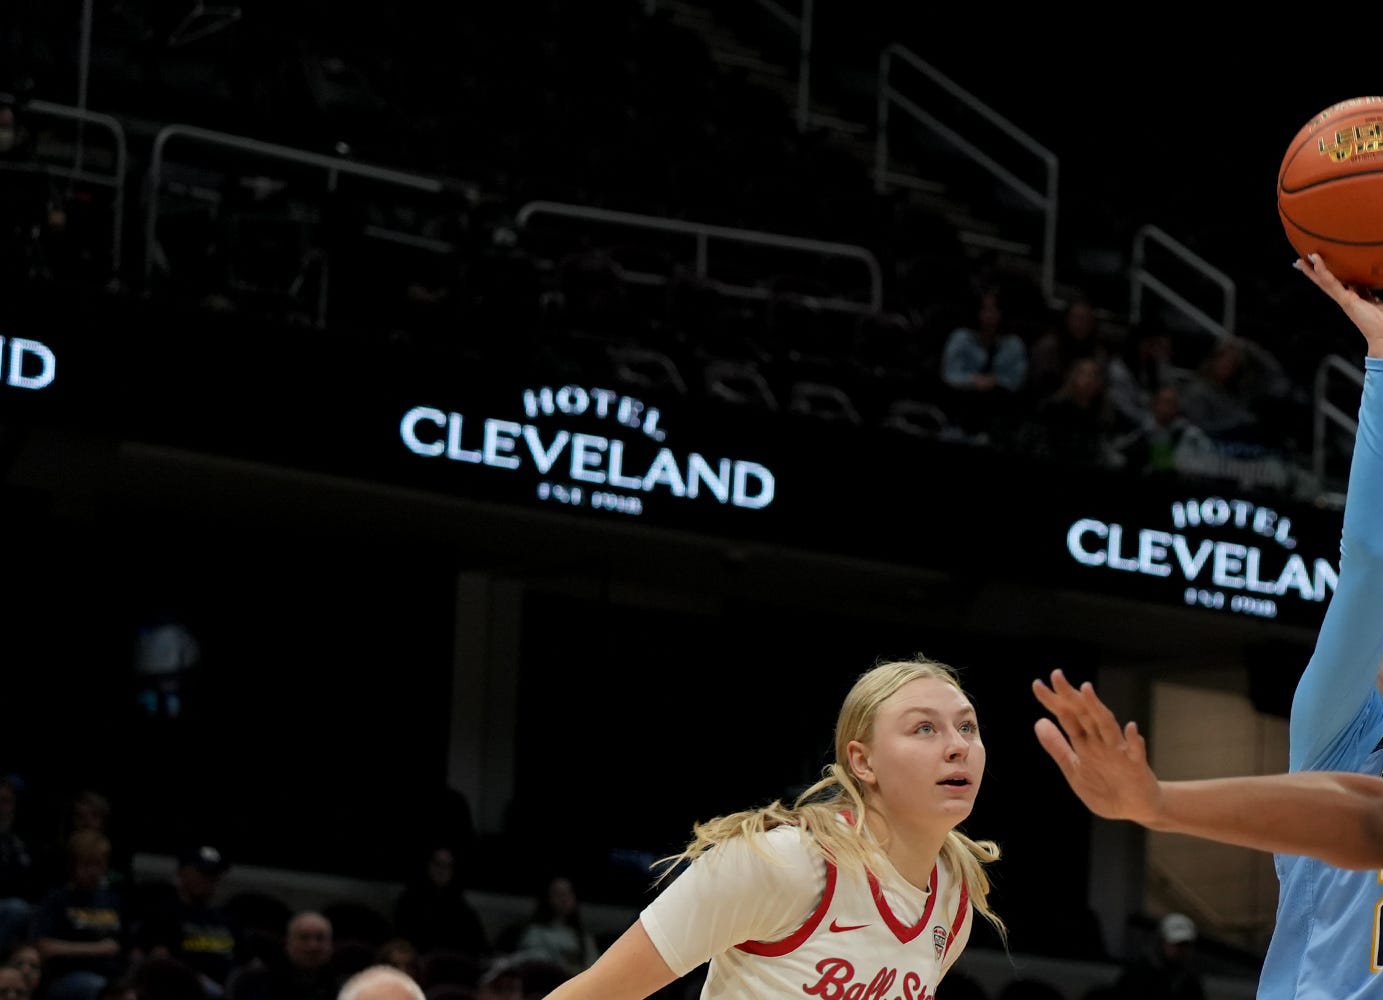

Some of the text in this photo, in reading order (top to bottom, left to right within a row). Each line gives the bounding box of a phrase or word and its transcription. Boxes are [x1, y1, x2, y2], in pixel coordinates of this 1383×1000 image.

[0, 335, 56, 390] D
[523, 385, 666, 442] HOTEL
[400, 404, 775, 509] CLEVELAND
[1172, 497, 1297, 549] HOTEL
[1066, 517, 1340, 601] CLEVELAN
